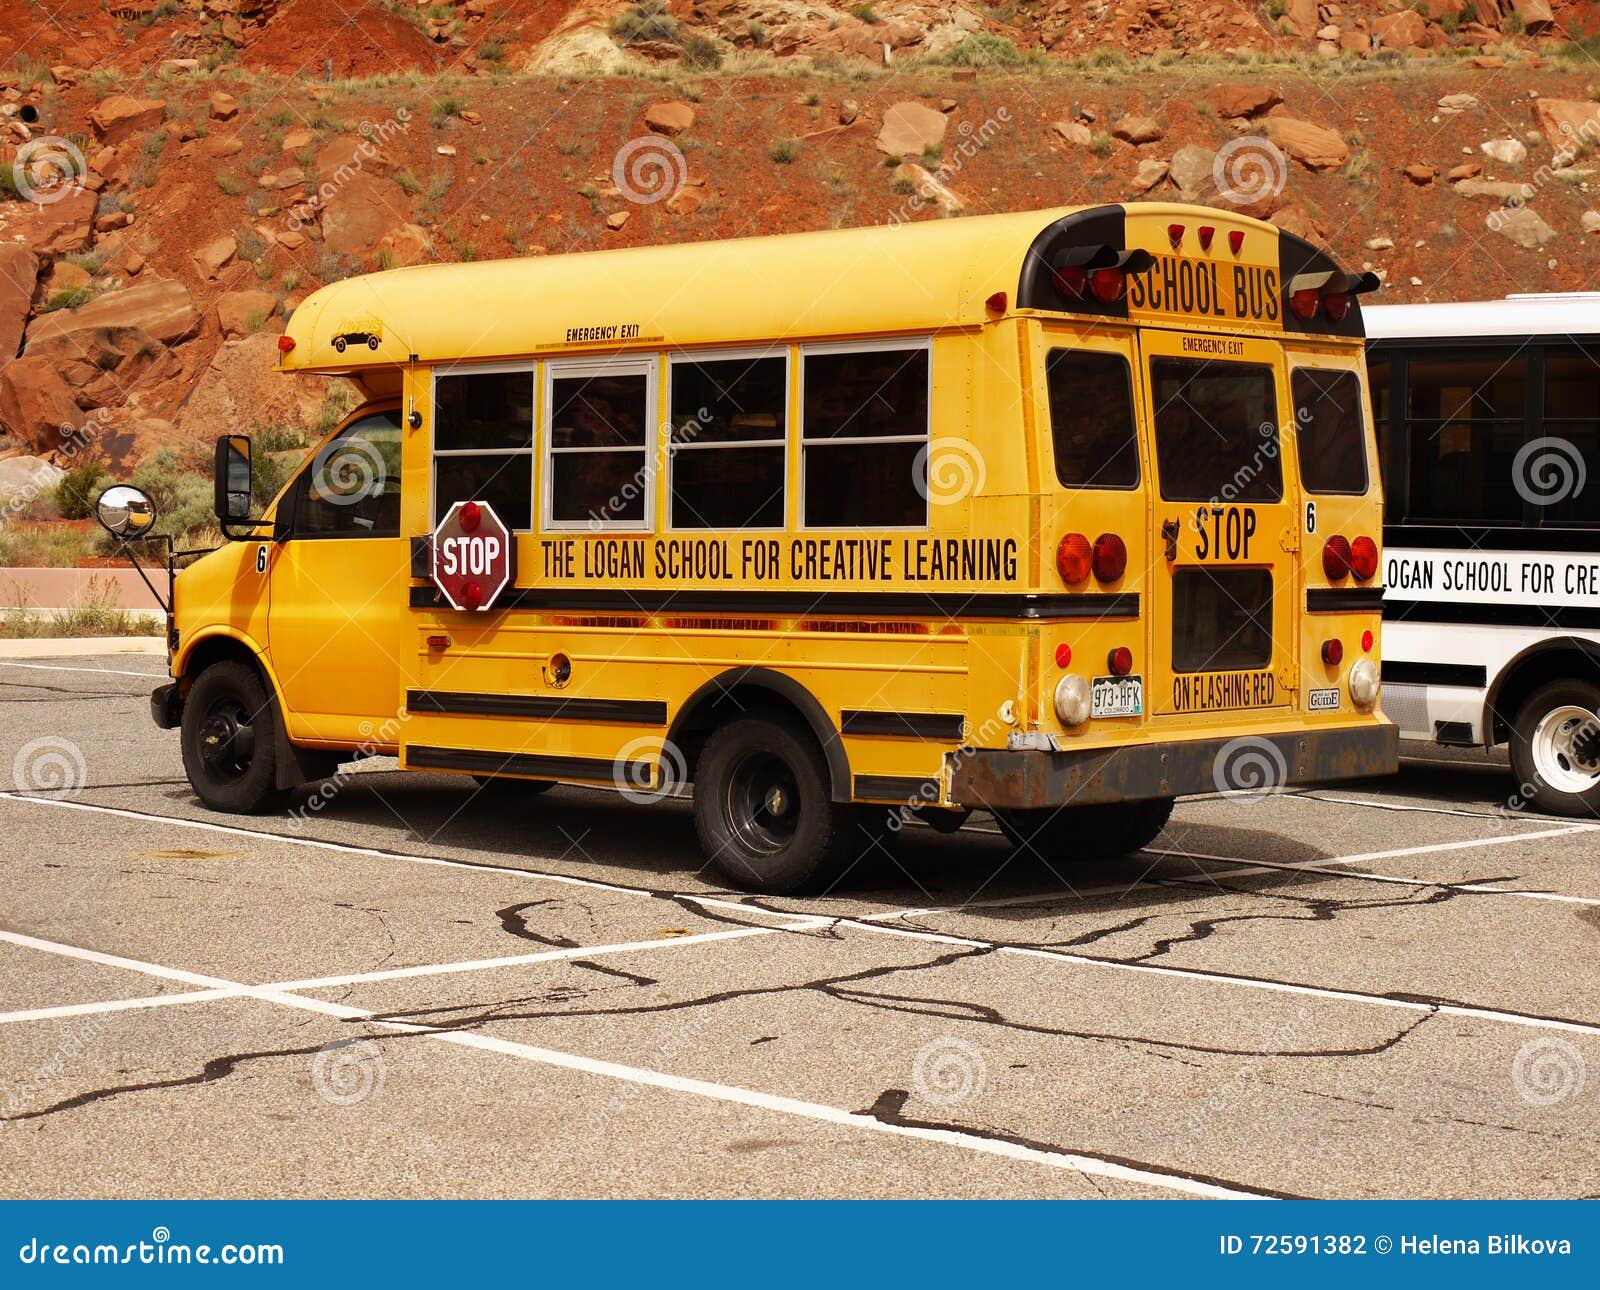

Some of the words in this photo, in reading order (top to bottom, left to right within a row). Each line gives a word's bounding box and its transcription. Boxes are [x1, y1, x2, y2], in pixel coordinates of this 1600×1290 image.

[1130, 255, 1225, 317] SCHOOL
[1233, 265, 1279, 321] BUS
[566, 326, 617, 341] EMERGENCY
[621, 324, 640, 338] EXIT
[1182, 337, 1226, 354] EMERGENCY
[1228, 342, 1244, 356] EXIT
[1196, 507, 1256, 560] STOP
[1306, 502, 1315, 533] 6
[257, 546, 267, 572] 6
[443, 536, 500, 577] STOP
[541, 540, 575, 578] THE
[584, 540, 645, 579] LOGAN
[655, 540, 733, 579] SCHOOL
[742, 540, 780, 580] FOR
[791, 539, 892, 580] CREATIVE
[904, 538, 1017, 580] LEARNING
[1383, 559, 1433, 589] OGAN
[1443, 560, 1512, 592] SCHOOL
[1522, 562, 1554, 593] FOR
[1565, 564, 1599, 595] CRE
[1173, 677, 1190, 710] ON
[1193, 674, 1250, 709] FLASHING
[1253, 672, 1275, 705] RED
[1311, 692, 1338, 706] GUIDE
